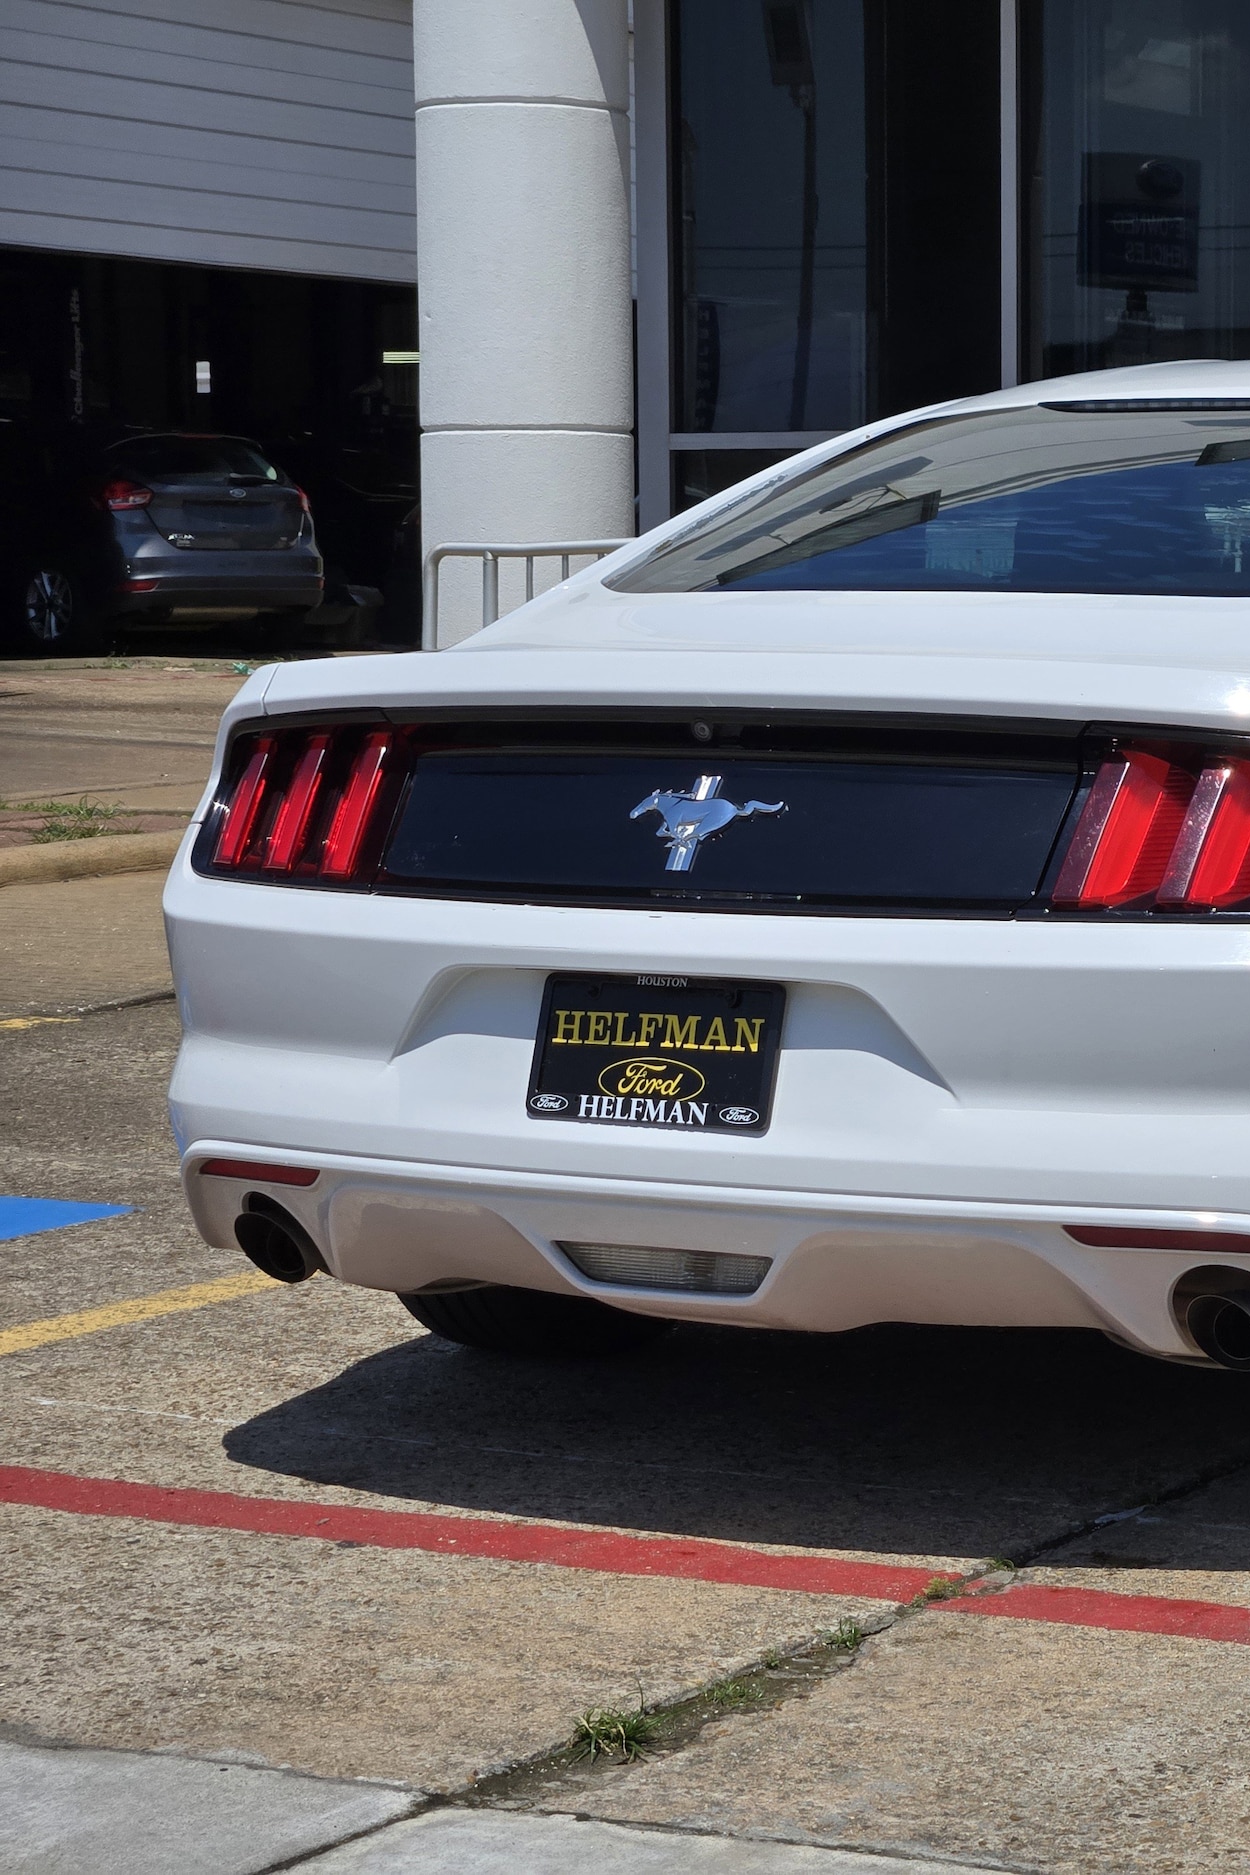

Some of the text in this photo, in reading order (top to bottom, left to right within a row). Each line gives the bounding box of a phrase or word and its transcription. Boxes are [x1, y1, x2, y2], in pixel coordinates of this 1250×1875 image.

[636, 975, 689, 988] HOUSTON
[552, 1010, 765, 1052] HELFMAN
[617, 1062, 683, 1096] Ford
[537, 1096, 562, 1109] Ford
[577, 1094, 709, 1125] HELFMAN
[726, 1108, 752, 1122] Ford
